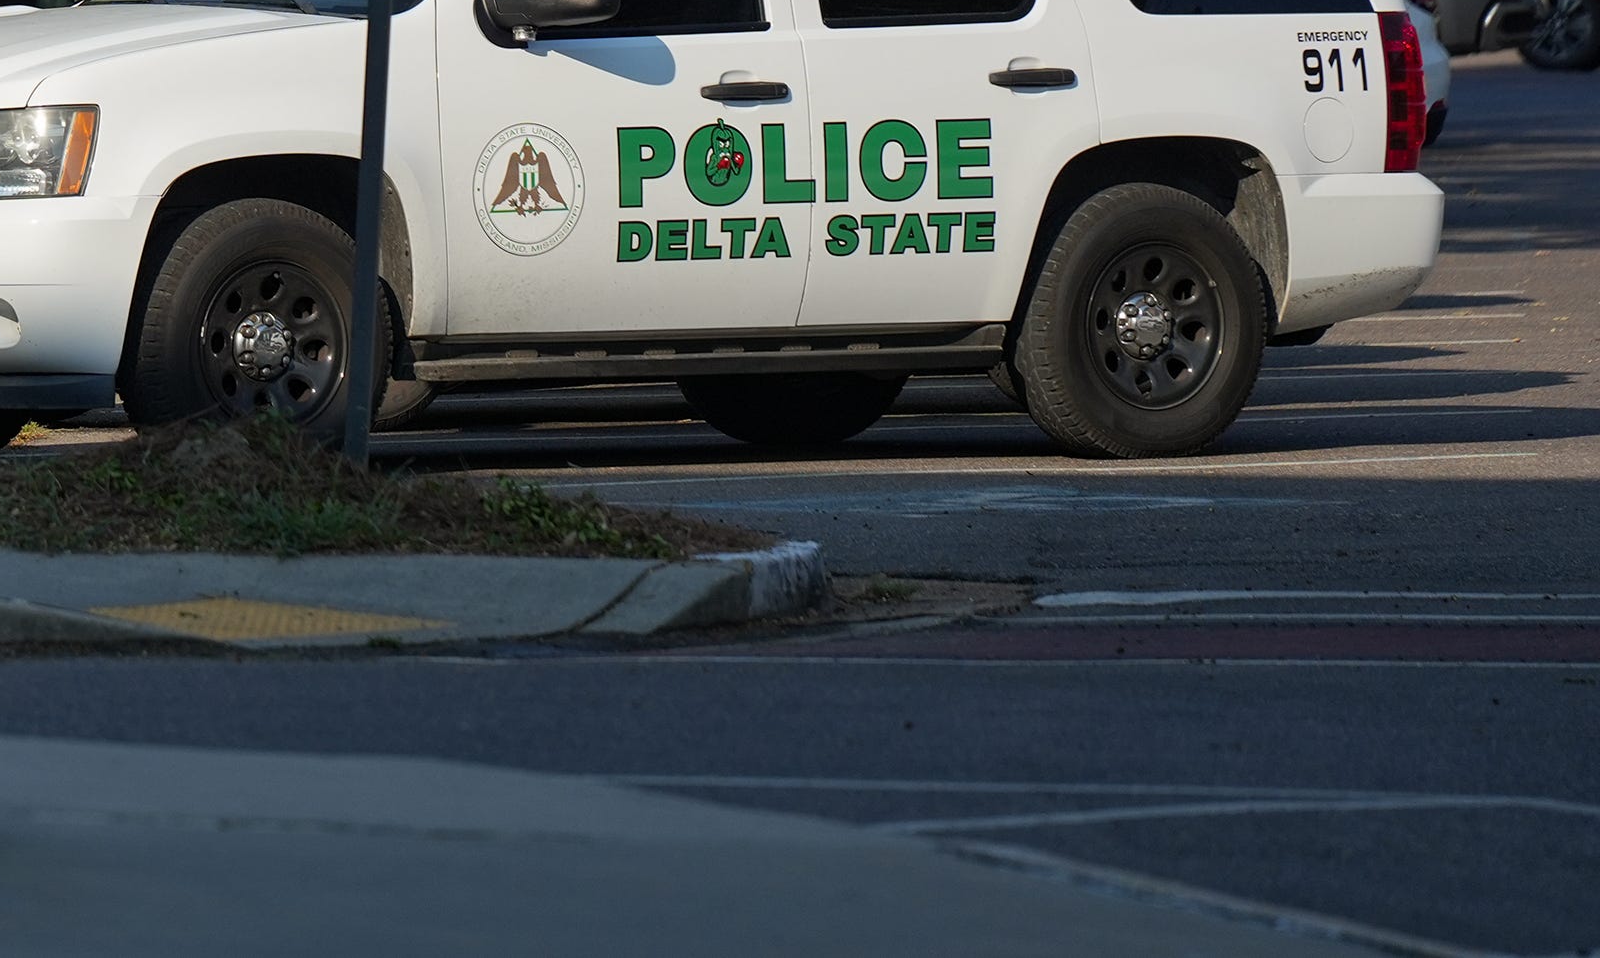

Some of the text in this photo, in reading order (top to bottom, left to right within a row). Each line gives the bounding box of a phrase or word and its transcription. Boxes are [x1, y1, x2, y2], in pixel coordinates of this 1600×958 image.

[1297, 31, 1368, 42] EMERGENCY
[1302, 48, 1368, 92] 911
[478, 127, 579, 174] DELTA STATE UNIVERSITY
[616, 118, 994, 208] POLICE
[616, 211, 996, 262] DELTA STATE
